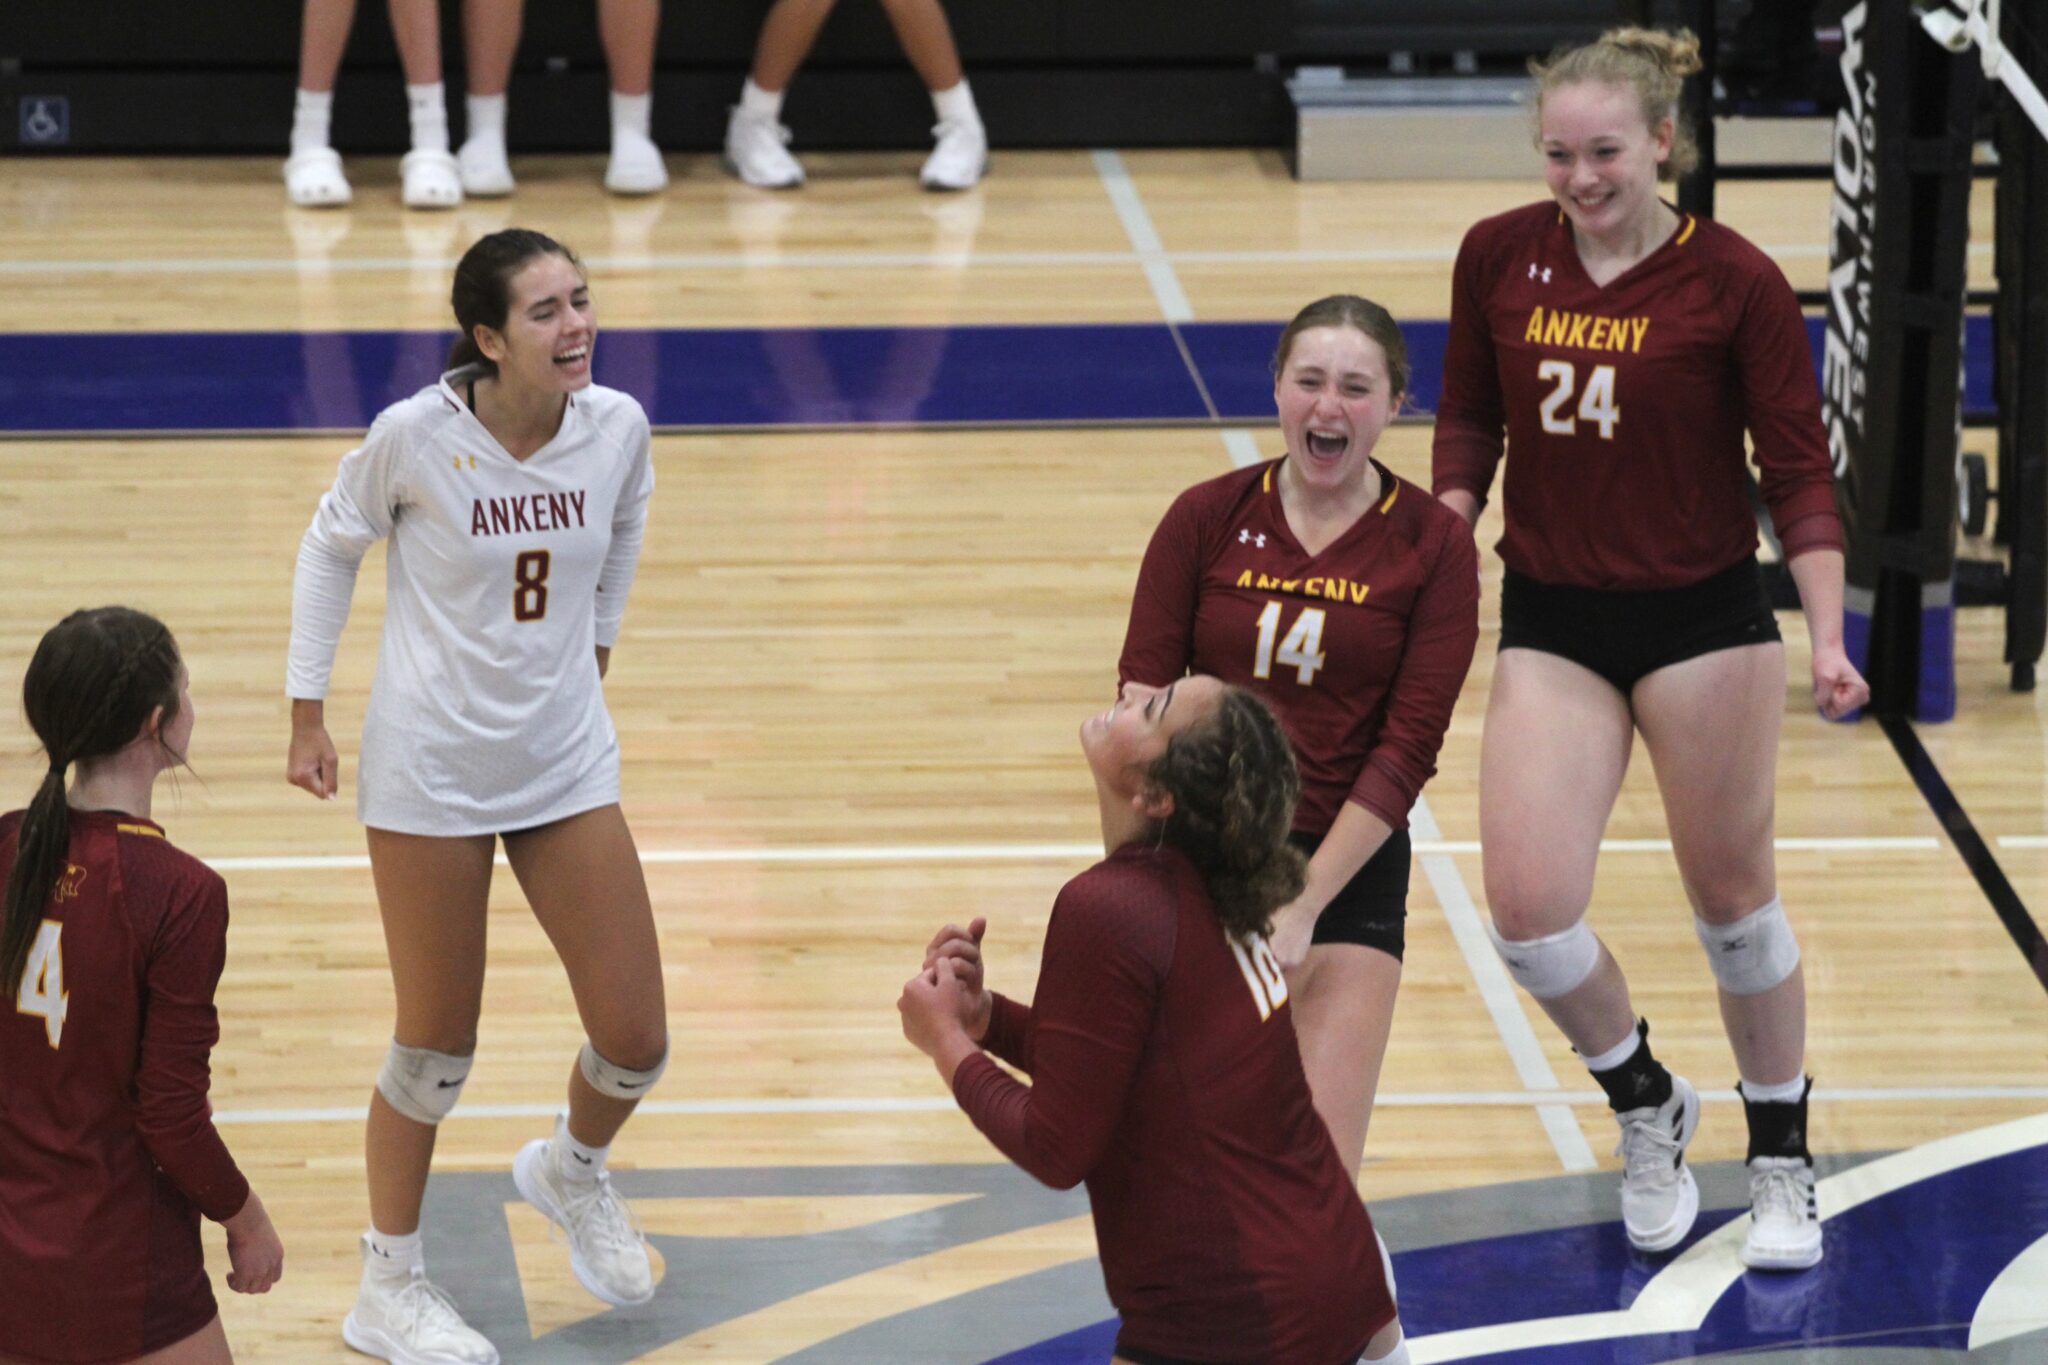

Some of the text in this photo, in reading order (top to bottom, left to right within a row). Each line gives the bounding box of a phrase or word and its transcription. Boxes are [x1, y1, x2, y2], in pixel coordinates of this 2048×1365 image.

[1821, 0, 1867, 478] WOLVES
[1850, 70, 1877, 438] NORTHWEST
[1525, 306, 1649, 353] ANKENY
[1537, 359, 1621, 440] 24
[471, 489, 585, 536] ANKENY
[513, 548, 551, 624] 8
[1253, 599, 1327, 686] 14
[16, 918, 69, 1051] 4
